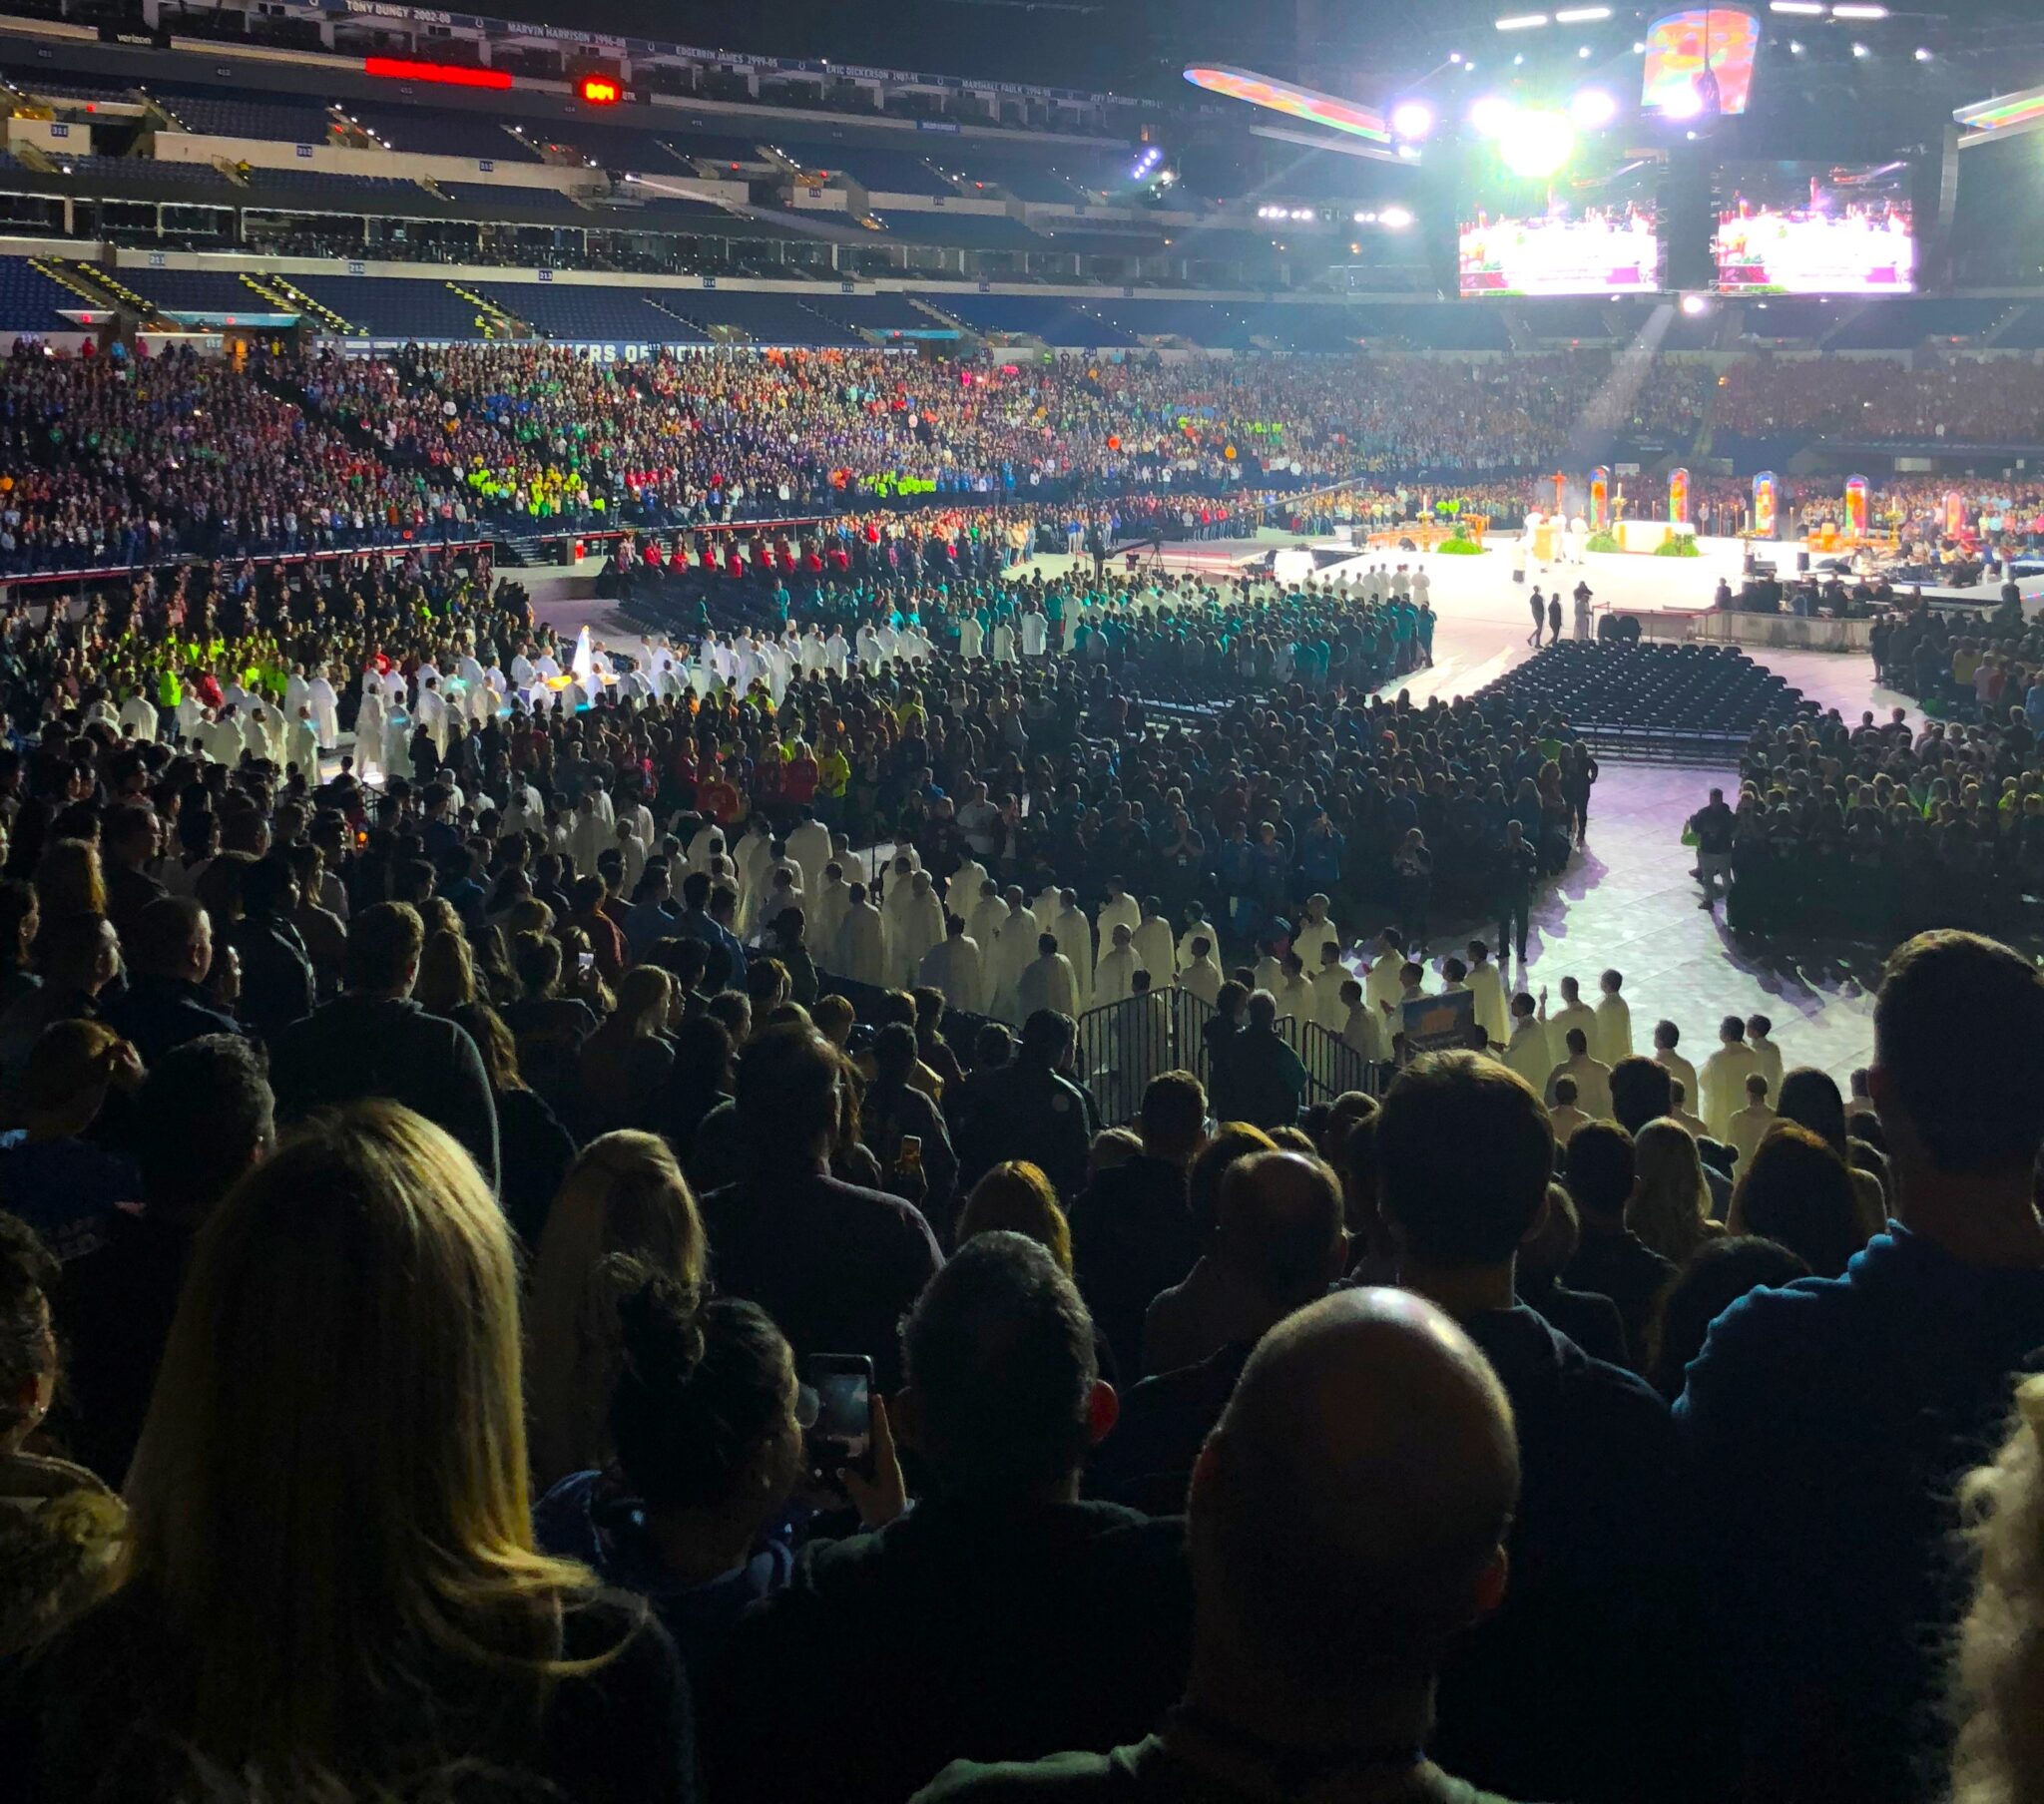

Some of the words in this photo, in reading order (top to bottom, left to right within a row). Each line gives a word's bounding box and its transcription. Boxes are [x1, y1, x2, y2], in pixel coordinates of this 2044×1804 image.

[346, 0, 373, 13] TONY
[375, 4, 409, 18] DUNGY
[117, 33, 152, 45] verizon
[508, 23, 544, 36] MARVIN
[546, 28, 591, 43] HARRISON
[718, 51, 744, 63] JAMES
[846, 67, 888, 80] DICKERSON
